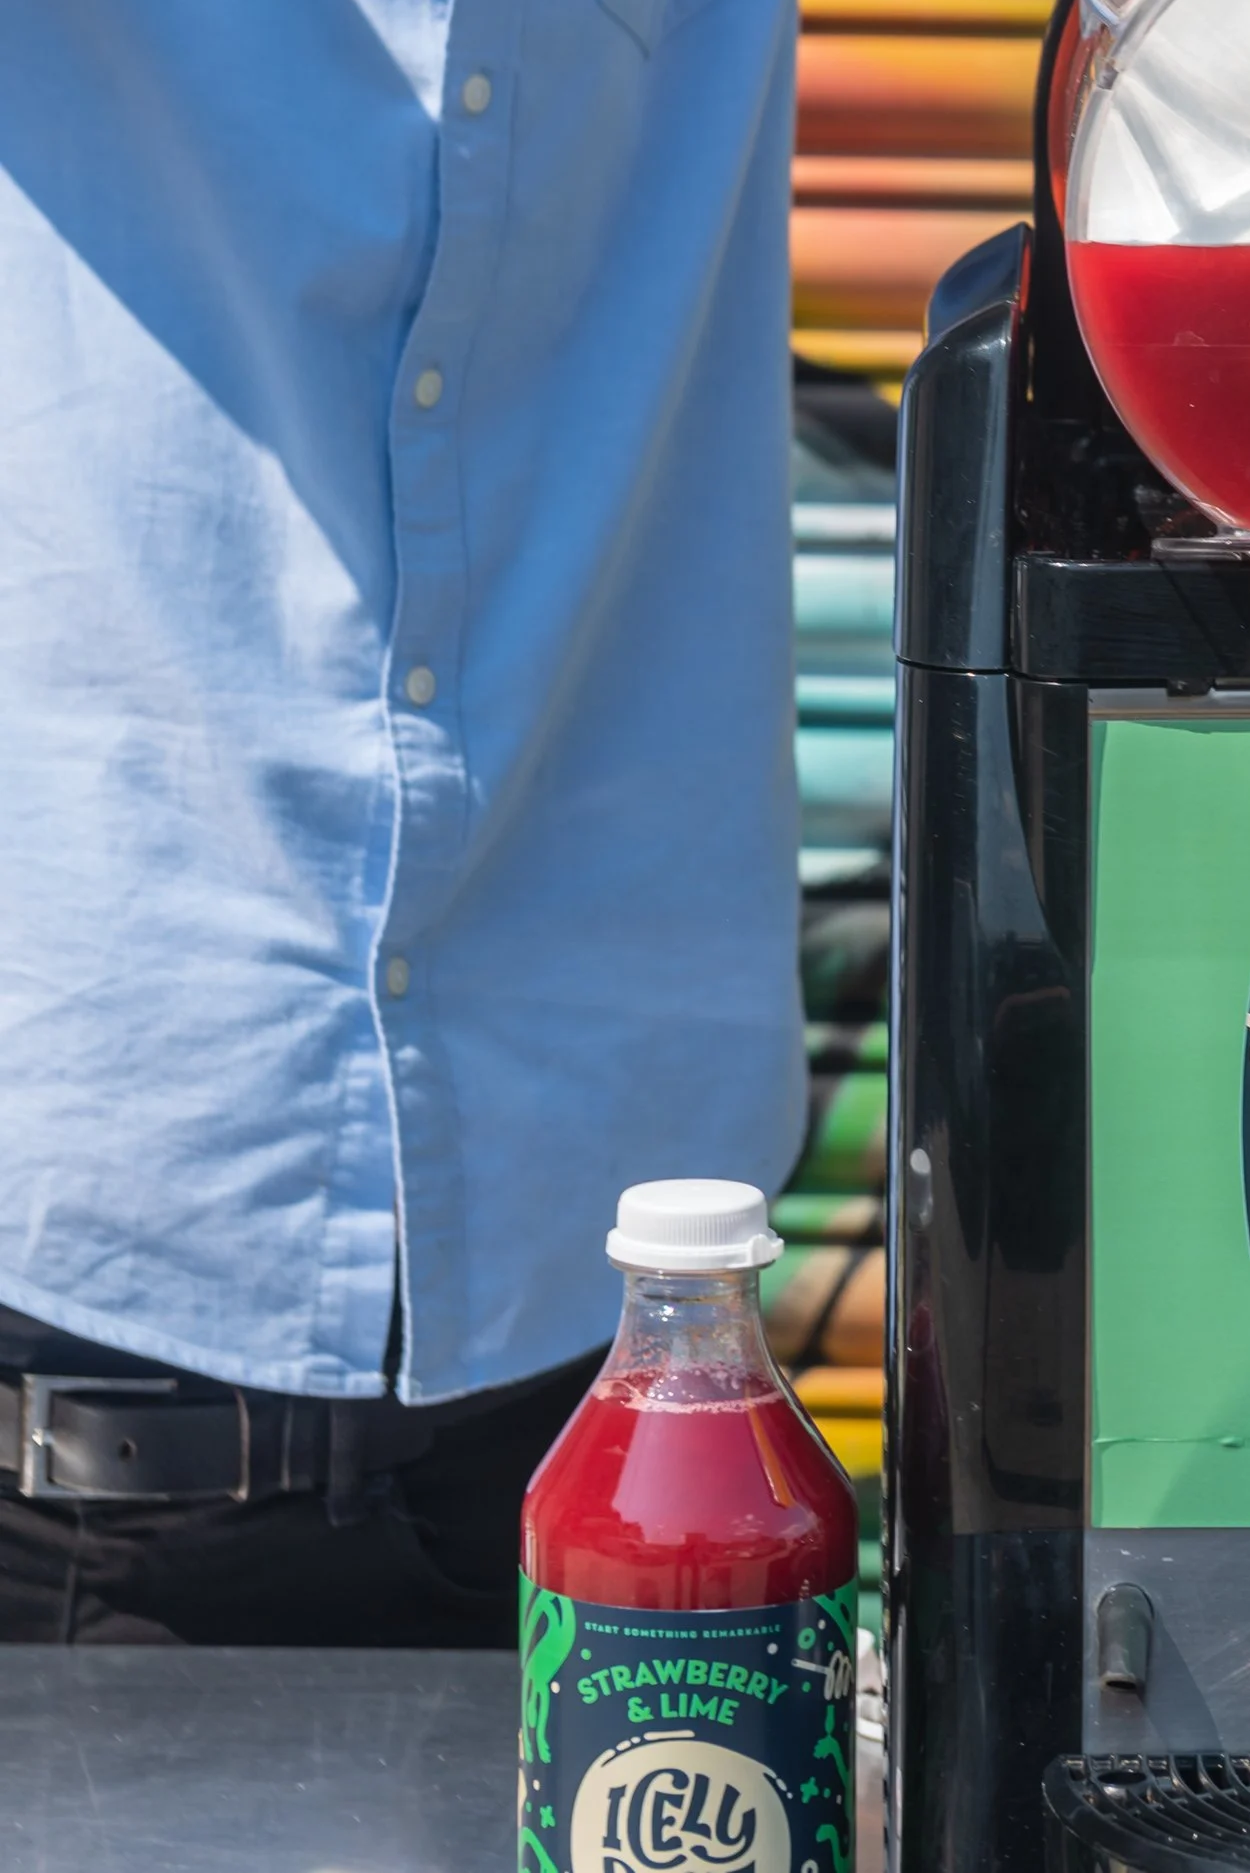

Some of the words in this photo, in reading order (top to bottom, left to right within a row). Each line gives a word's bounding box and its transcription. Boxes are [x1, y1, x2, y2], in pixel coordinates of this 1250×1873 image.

[584, 1621, 620, 1635] START
[624, 1626, 698, 1639] SOMETHING
[577, 1659, 789, 1705] STRAWBERRY
[627, 1696, 654, 1723] &
[660, 1692, 740, 1726] LIME
[603, 1768, 756, 1870] ICELY
